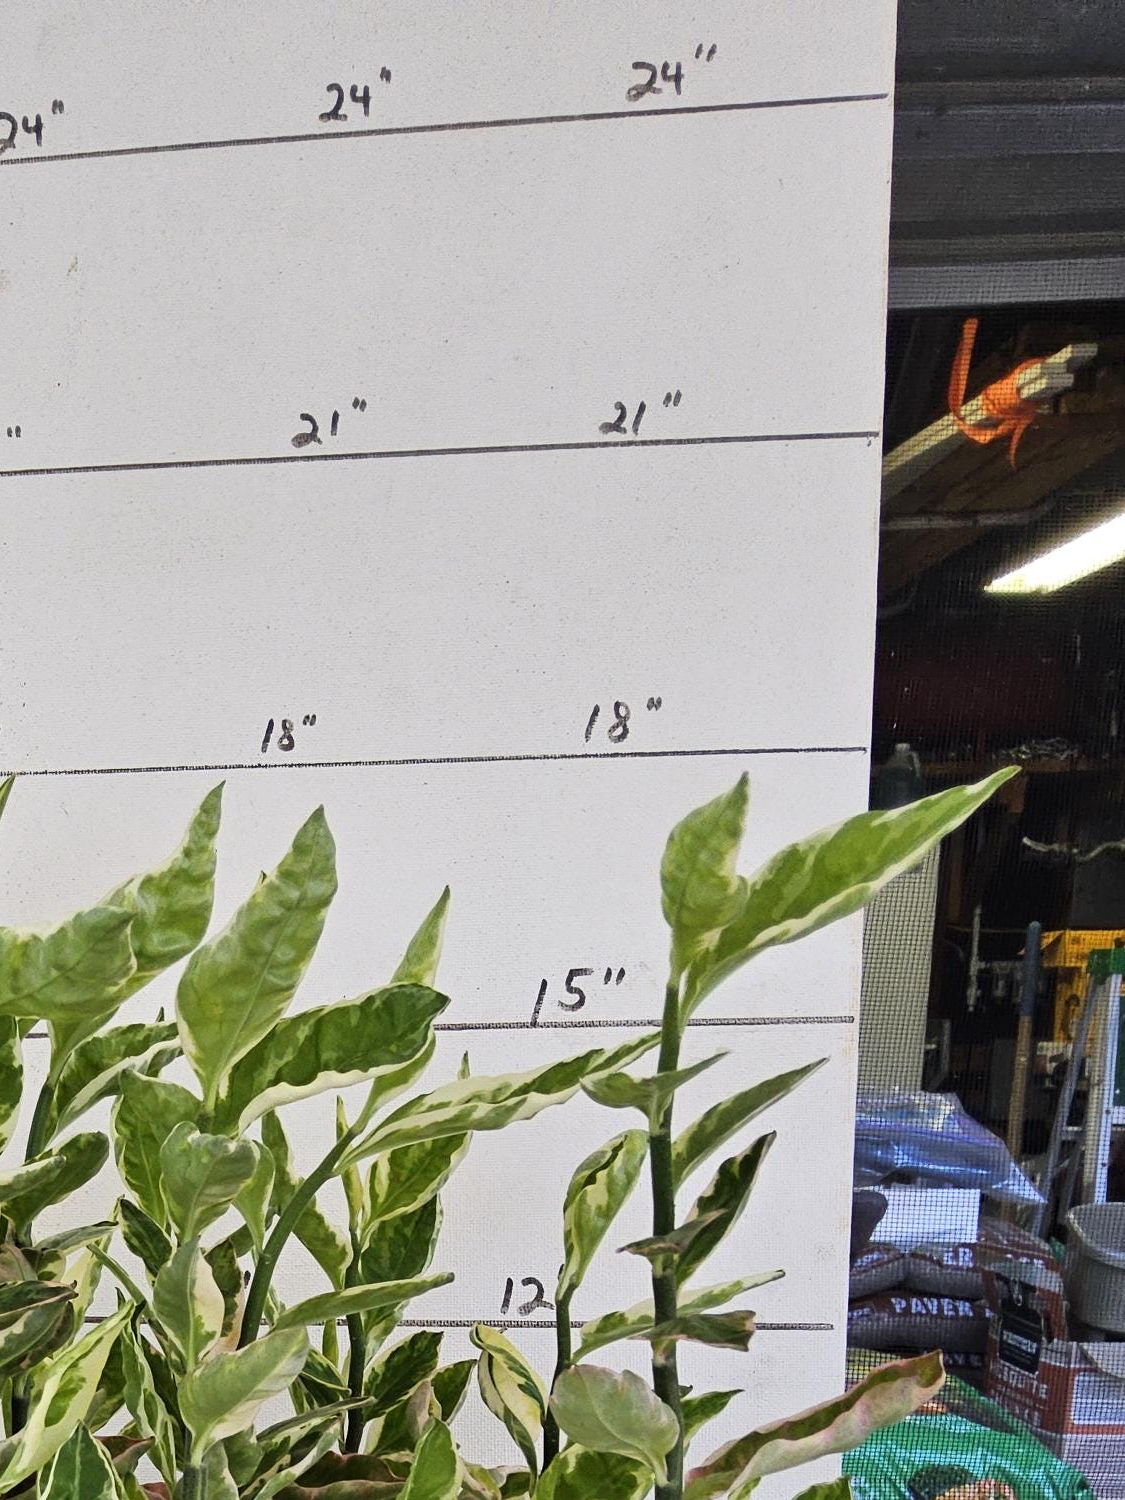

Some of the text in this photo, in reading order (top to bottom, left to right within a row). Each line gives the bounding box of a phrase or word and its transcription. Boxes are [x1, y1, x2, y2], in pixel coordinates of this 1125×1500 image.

[318, 66, 392, 123] 24"
[626, 43, 717, 101] 24"
[291, 396, 368, 448] 21"
[598, 389, 683, 436] 21"
[261, 713, 317, 754] 18"
[584, 696, 663, 744] 18"
[529, 966, 627, 1026] 15"
[890, 1296, 974, 1318] PAVER
